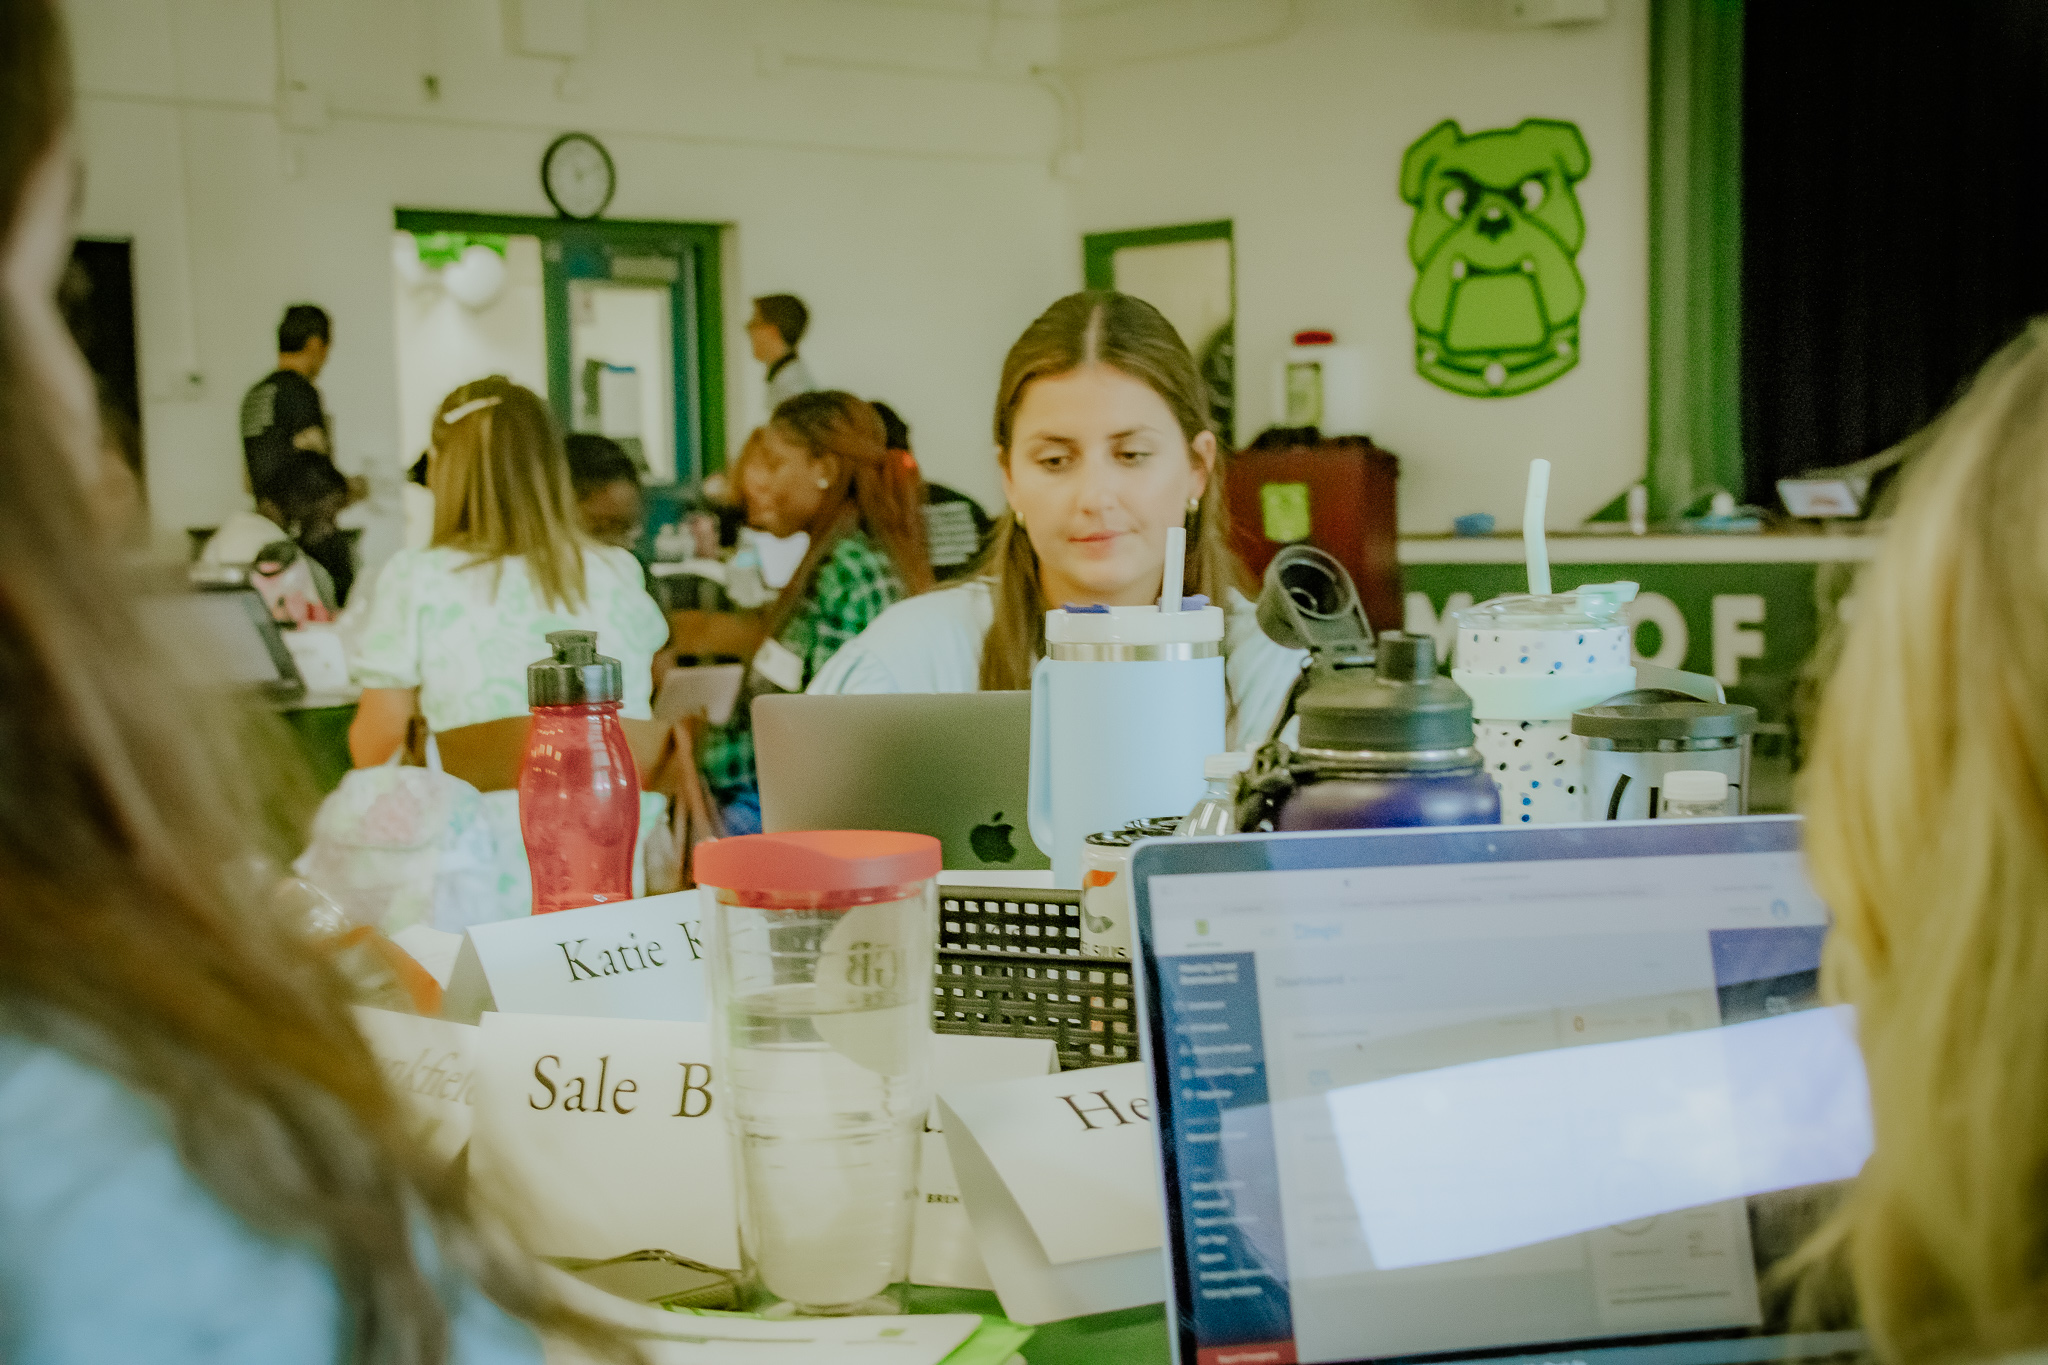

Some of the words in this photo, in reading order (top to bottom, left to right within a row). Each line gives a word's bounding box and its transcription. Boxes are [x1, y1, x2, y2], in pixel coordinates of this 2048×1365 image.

[1622, 592, 1766, 687] OF
[556, 931, 666, 983] Katie
[528, 1054, 638, 1116] Sale
[671, 1062, 713, 1118] B
[1055, 1090, 1149, 1131] He
